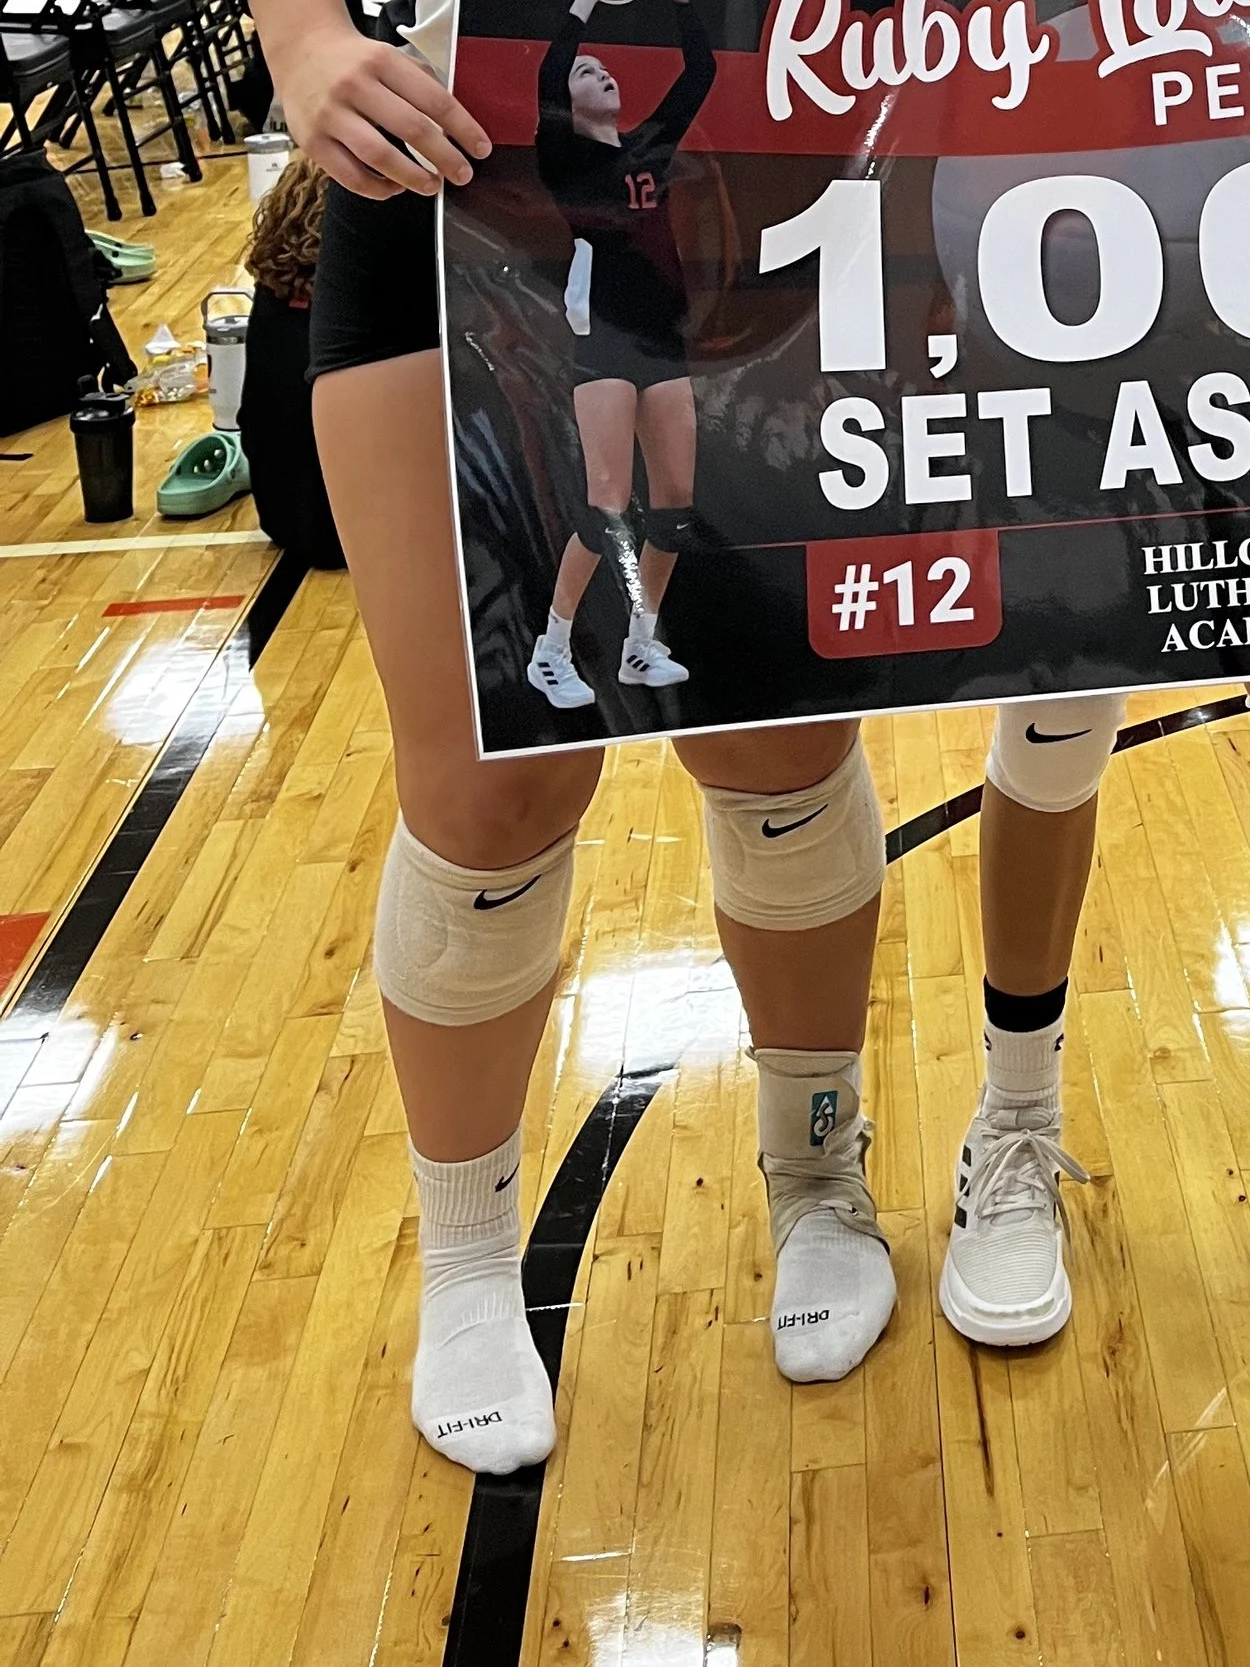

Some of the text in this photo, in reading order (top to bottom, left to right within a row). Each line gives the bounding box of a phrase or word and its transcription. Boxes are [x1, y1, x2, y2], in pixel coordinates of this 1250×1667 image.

[625, 172, 657, 210] 12
[817, 387, 1052, 512] SET
[830, 555, 975, 632] #12
[777, 1309, 830, 1331] DRI-FIT
[437, 1411, 502, 1439] DRI-FIT
